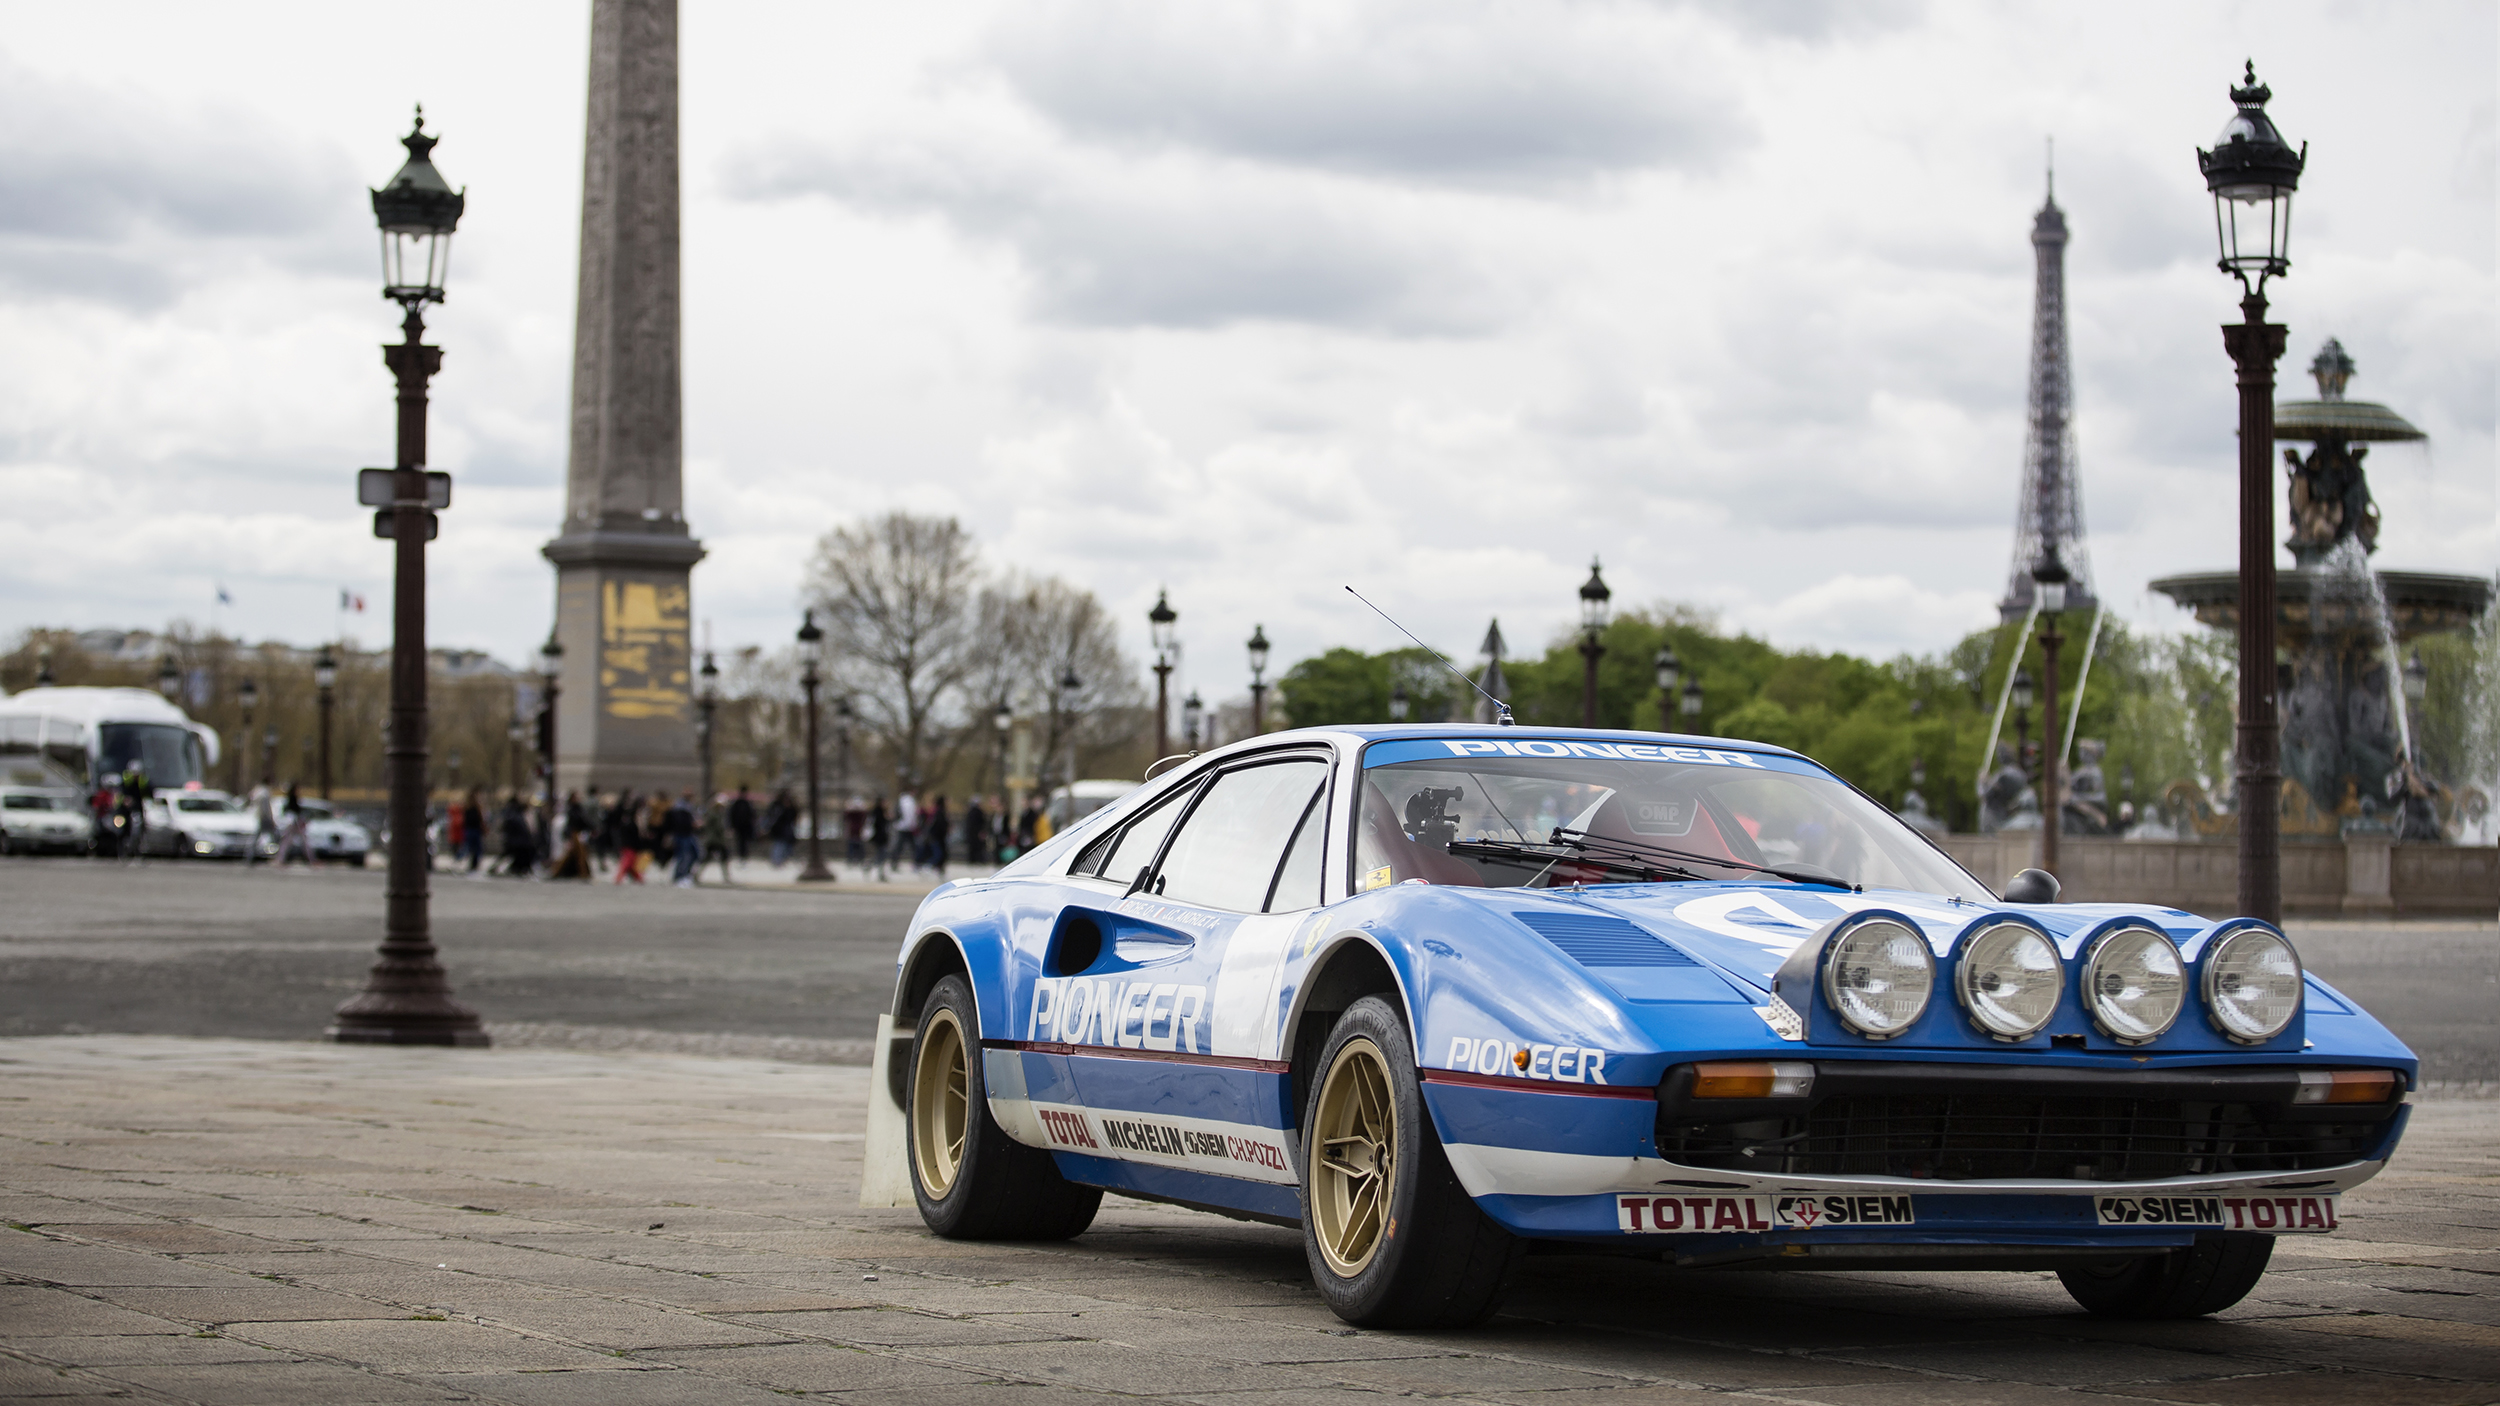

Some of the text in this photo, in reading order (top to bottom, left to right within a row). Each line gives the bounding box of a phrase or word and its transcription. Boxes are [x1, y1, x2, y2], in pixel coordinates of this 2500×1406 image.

[1441, 740, 1766, 768] PIONEER
[1639, 805, 1680, 821] OMP
[1027, 978, 1207, 1054] PIONEER
[1446, 1037, 1608, 1085] PIONEER
[1039, 1110, 1099, 1149] TOTAL
[1102, 1119, 1187, 1156] MICHELIN
[1199, 1132, 1229, 1158] SIEM
[1620, 1198, 1769, 1230] TOTAL
[1824, 1196, 1912, 1223] SIEM
[2142, 1197, 2224, 1223] SIEM
[2222, 1198, 2338, 1229] TOTAL
